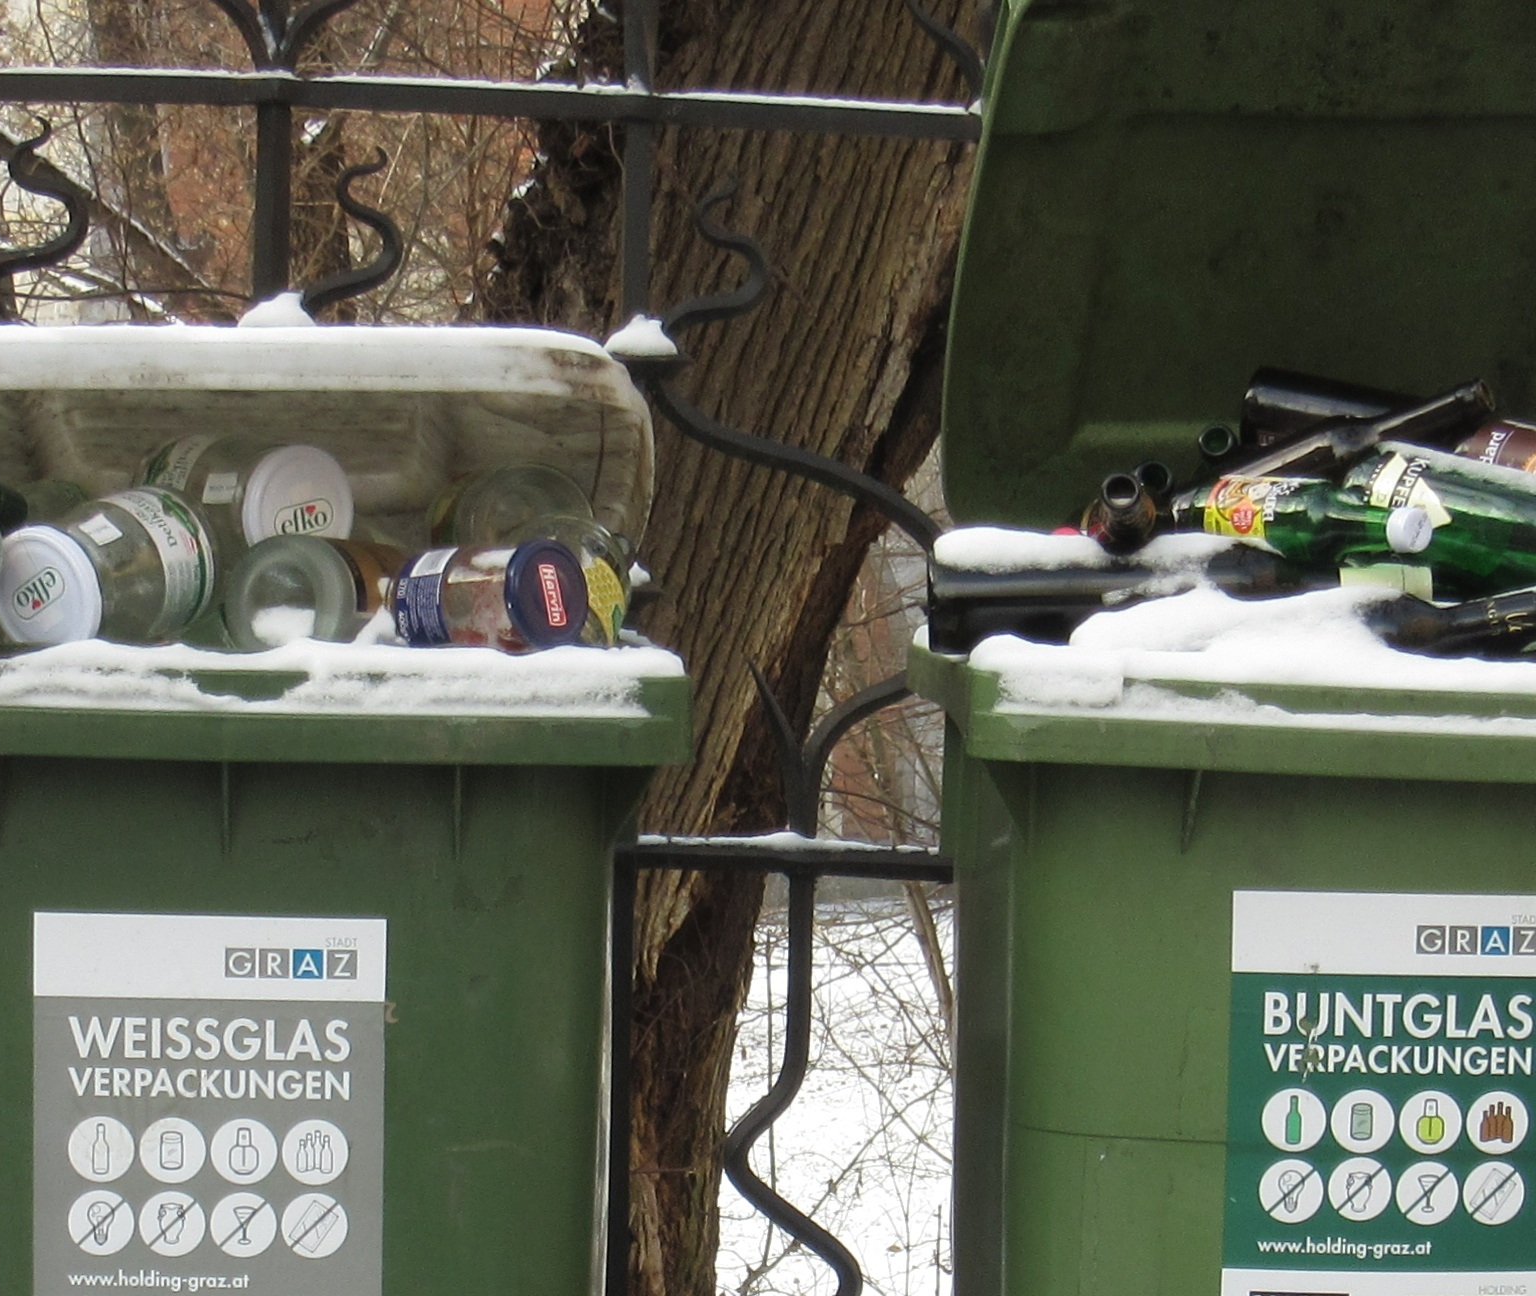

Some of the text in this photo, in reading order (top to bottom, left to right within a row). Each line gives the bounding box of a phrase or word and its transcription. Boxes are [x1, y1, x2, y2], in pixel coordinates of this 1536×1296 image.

[1480, 432, 1506, 464] dard
[1390, 458, 1430, 508] KUPFE
[281, 504, 327, 536] efko
[16, 571, 56, 608] efko
[542, 567, 562, 623] Harvin
[325, 937, 358, 948] STADT
[226, 949, 356, 979] GRAZ
[1263, 991, 1533, 1040] BUNTGLAS
[68, 1016, 351, 1063] WEISSGLAS
[1264, 1044, 1532, 1076] VERPACKUNGEN
[68, 1067, 351, 1101] VERPACKUNGEN
[1257, 1239, 1432, 1259] www.holding-graz.at
[68, 1270, 250, 1292] www.holding-graz.at
[1478, 1285, 1527, 1296] HOLDING
